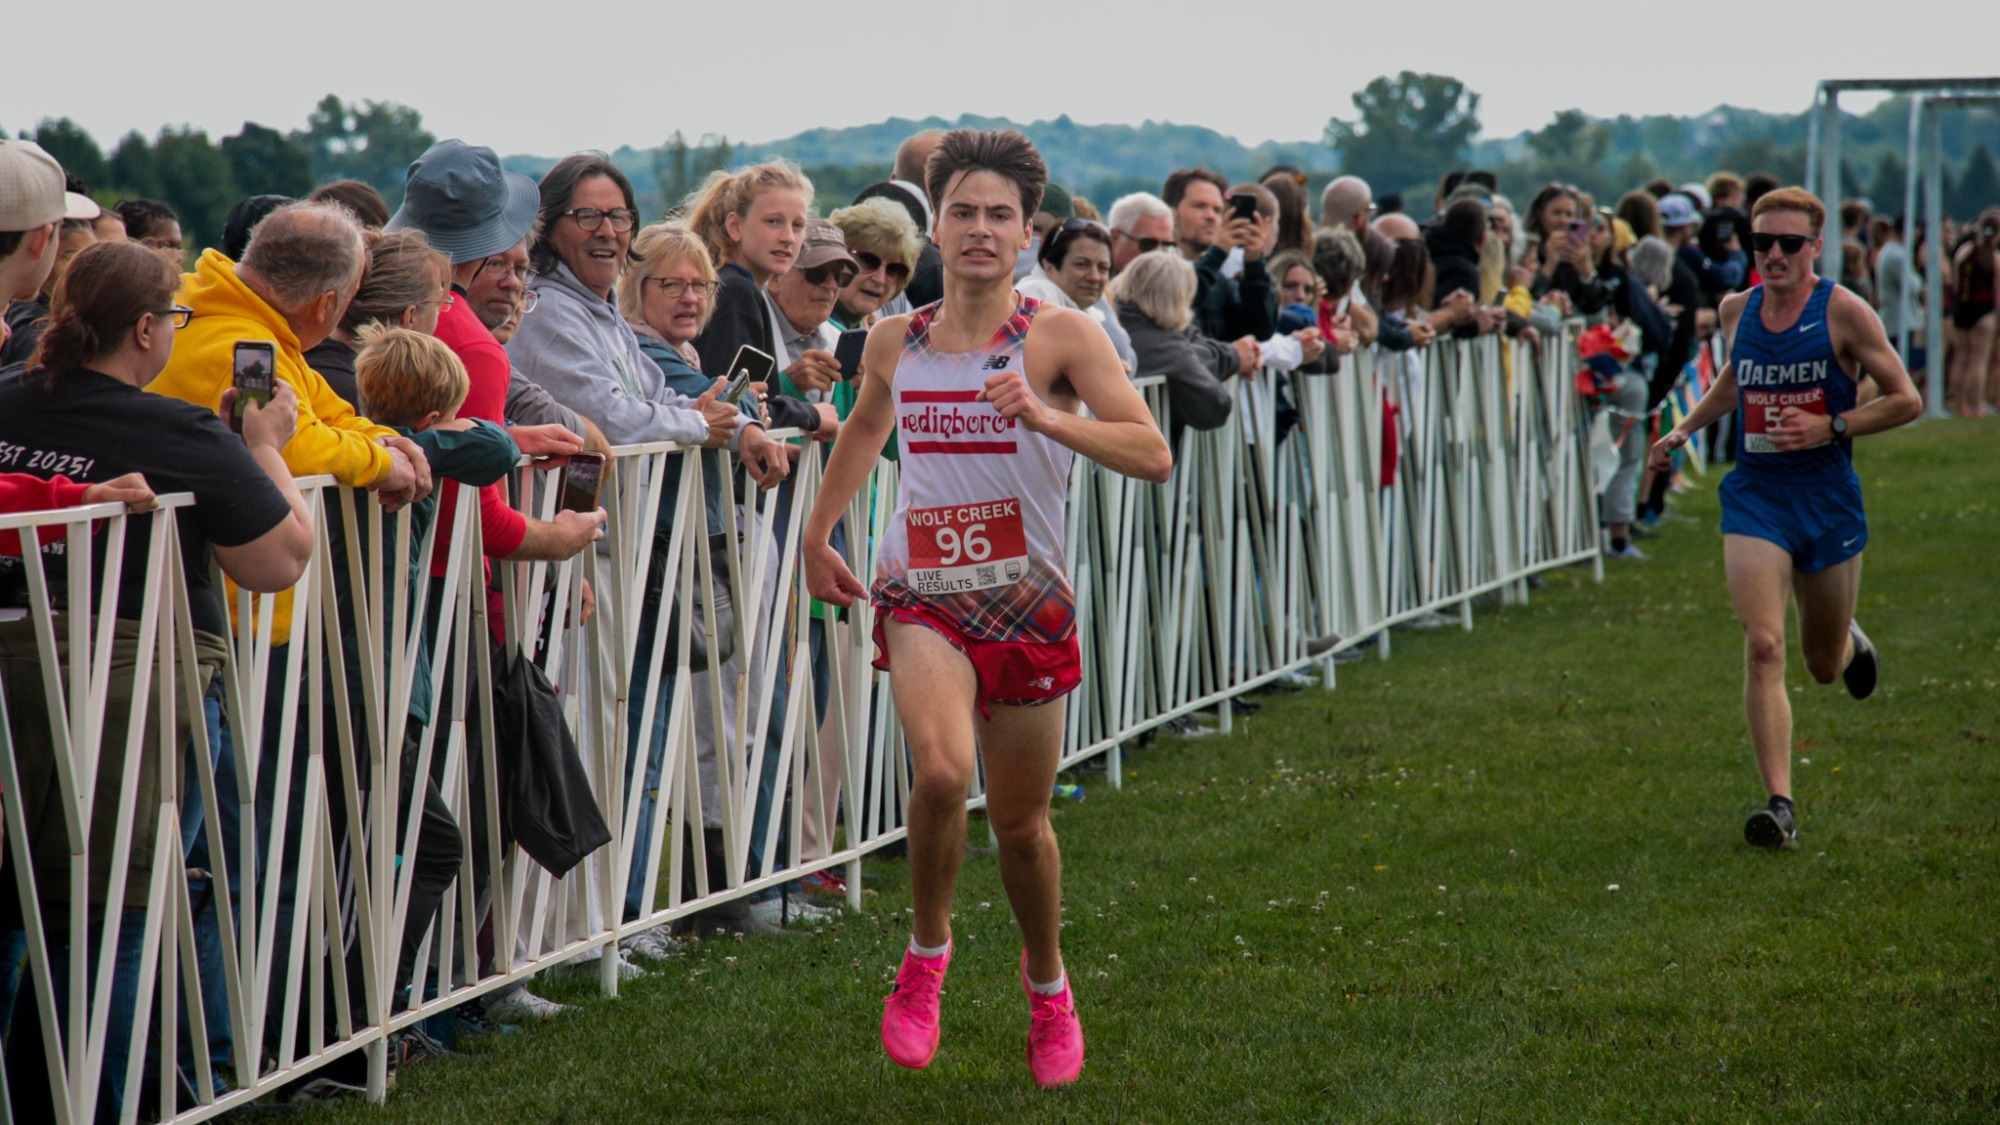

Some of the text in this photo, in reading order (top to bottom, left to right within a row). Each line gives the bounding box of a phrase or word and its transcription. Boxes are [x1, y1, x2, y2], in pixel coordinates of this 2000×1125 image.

[1737, 359, 1827, 387] DAEMEN
[1746, 389, 1822, 405] WOLF CREEK
[908, 405, 1007, 439] edinboro
[26, 450, 95, 478] 2025!
[909, 501, 1016, 526] WOLF CREEK
[936, 523, 991, 565] 96
[916, 570, 943, 581] LIVE
[918, 578, 973, 593] RESULTS
